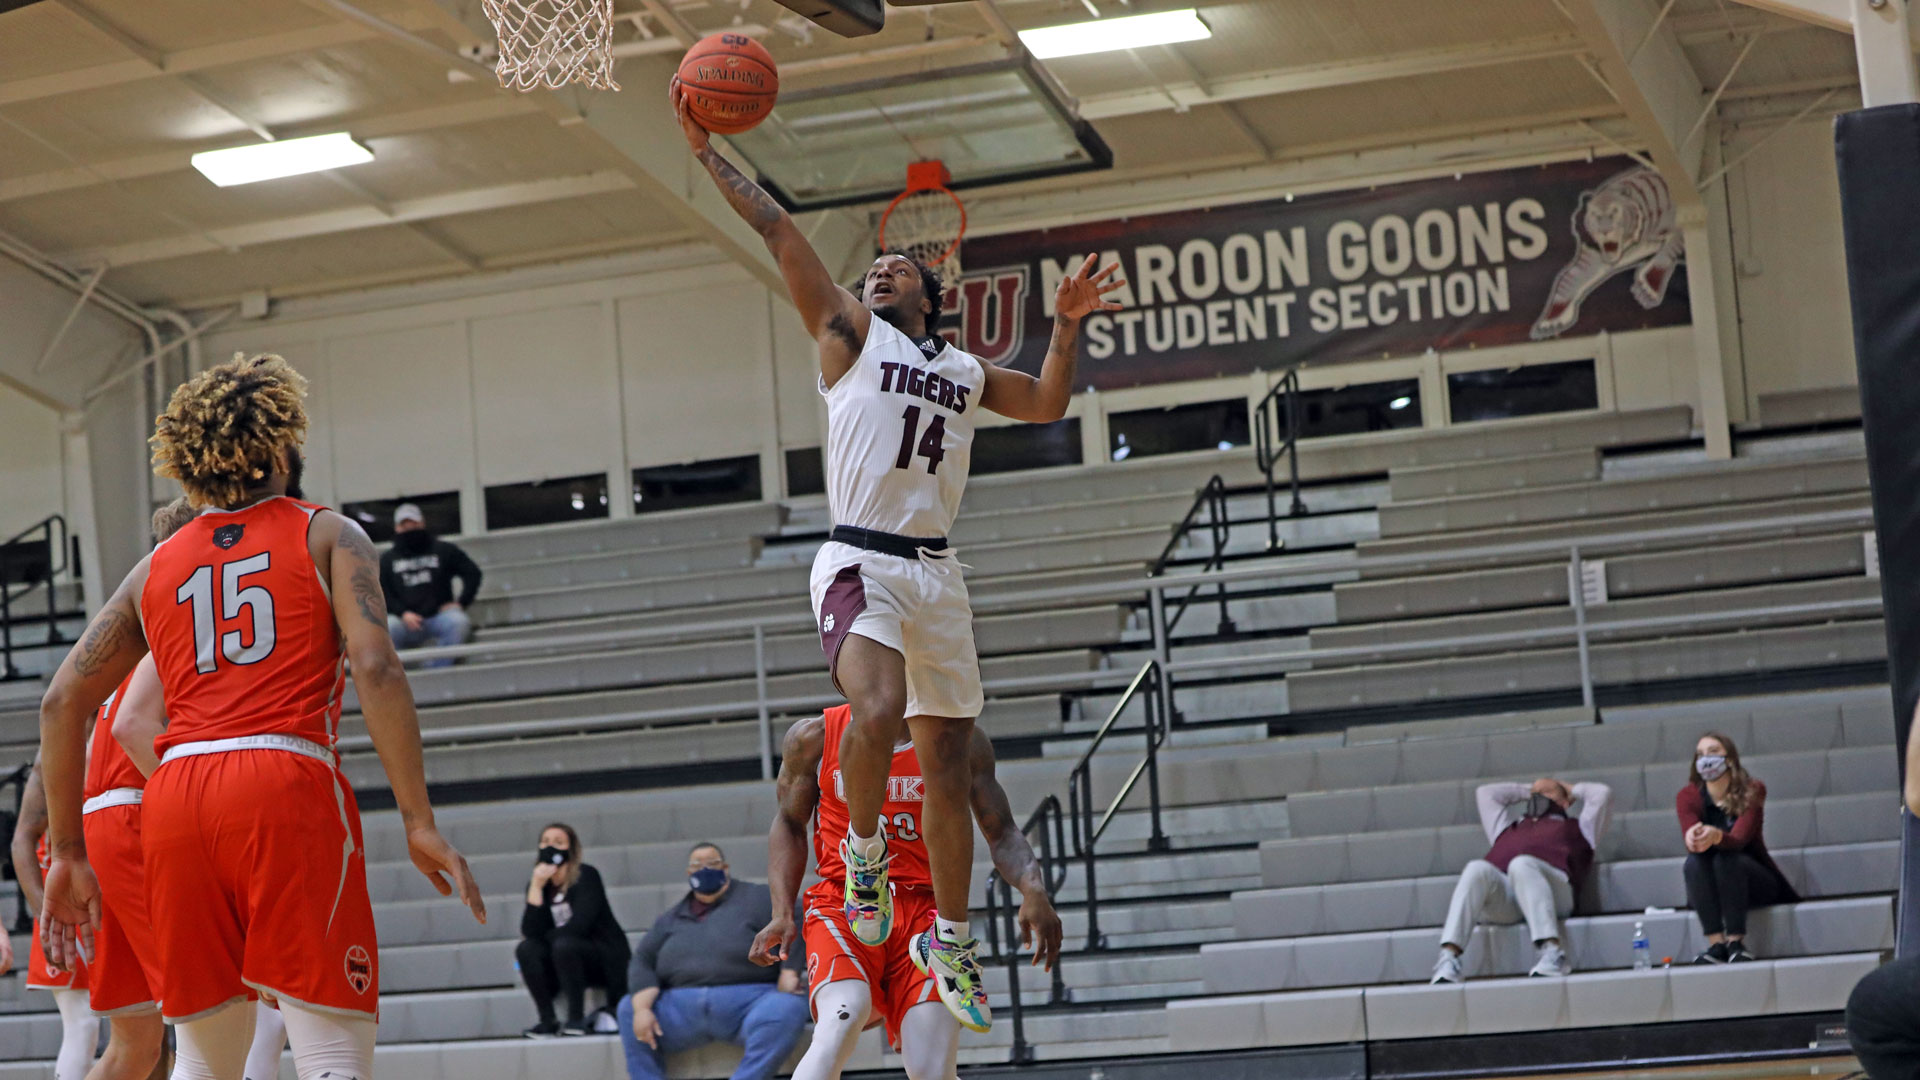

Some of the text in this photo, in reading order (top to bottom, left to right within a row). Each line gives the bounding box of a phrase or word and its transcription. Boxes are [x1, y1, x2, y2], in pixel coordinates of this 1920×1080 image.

[696, 66, 765, 88] SPALDING
[1329, 199, 1548, 275] GOONS
[1085, 268, 1510, 360] STUDENT SECTION
[880, 361, 971, 415] TIGERS
[895, 404, 946, 475] 14
[176, 551, 277, 675] 15
